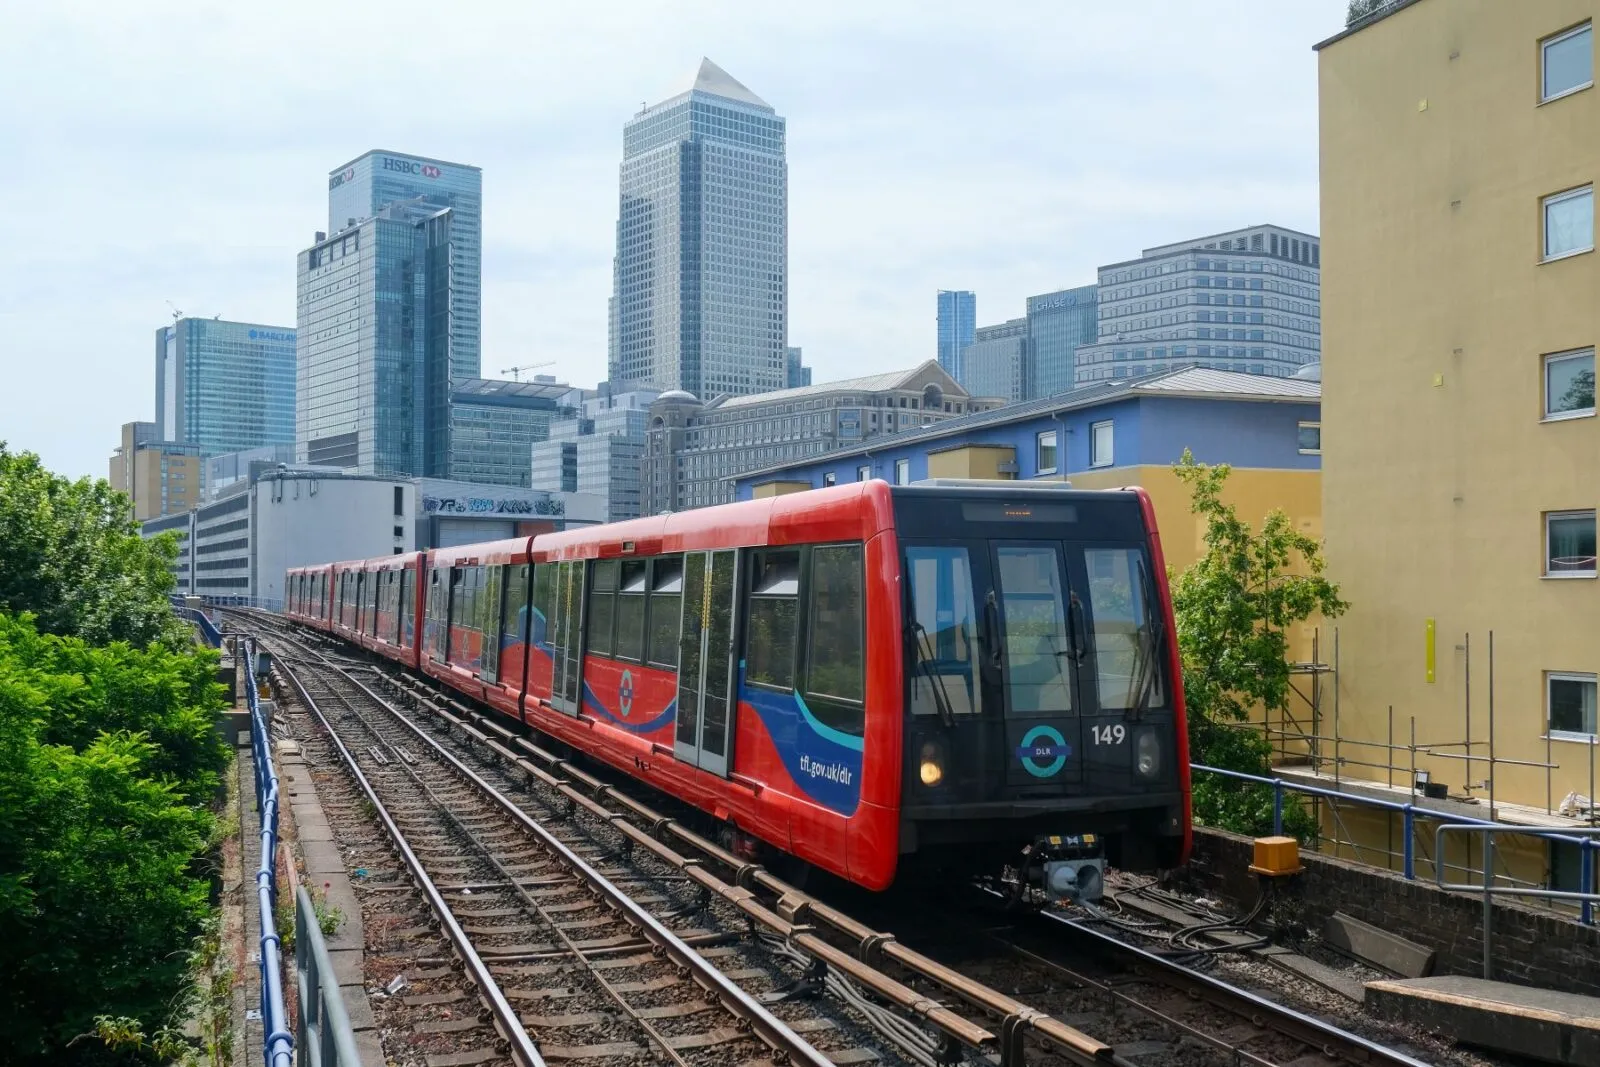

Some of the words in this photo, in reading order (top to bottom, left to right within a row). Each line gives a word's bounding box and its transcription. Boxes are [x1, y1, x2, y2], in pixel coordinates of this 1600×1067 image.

[383, 157, 421, 176] HSBC
[329, 171, 346, 191] HSBC
[1036, 298, 1066, 311] CHASE
[1091, 724, 1126, 745] 149
[1035, 747, 1052, 756] DLR
[799, 754, 853, 786] tfl.gov.uk/dlr
